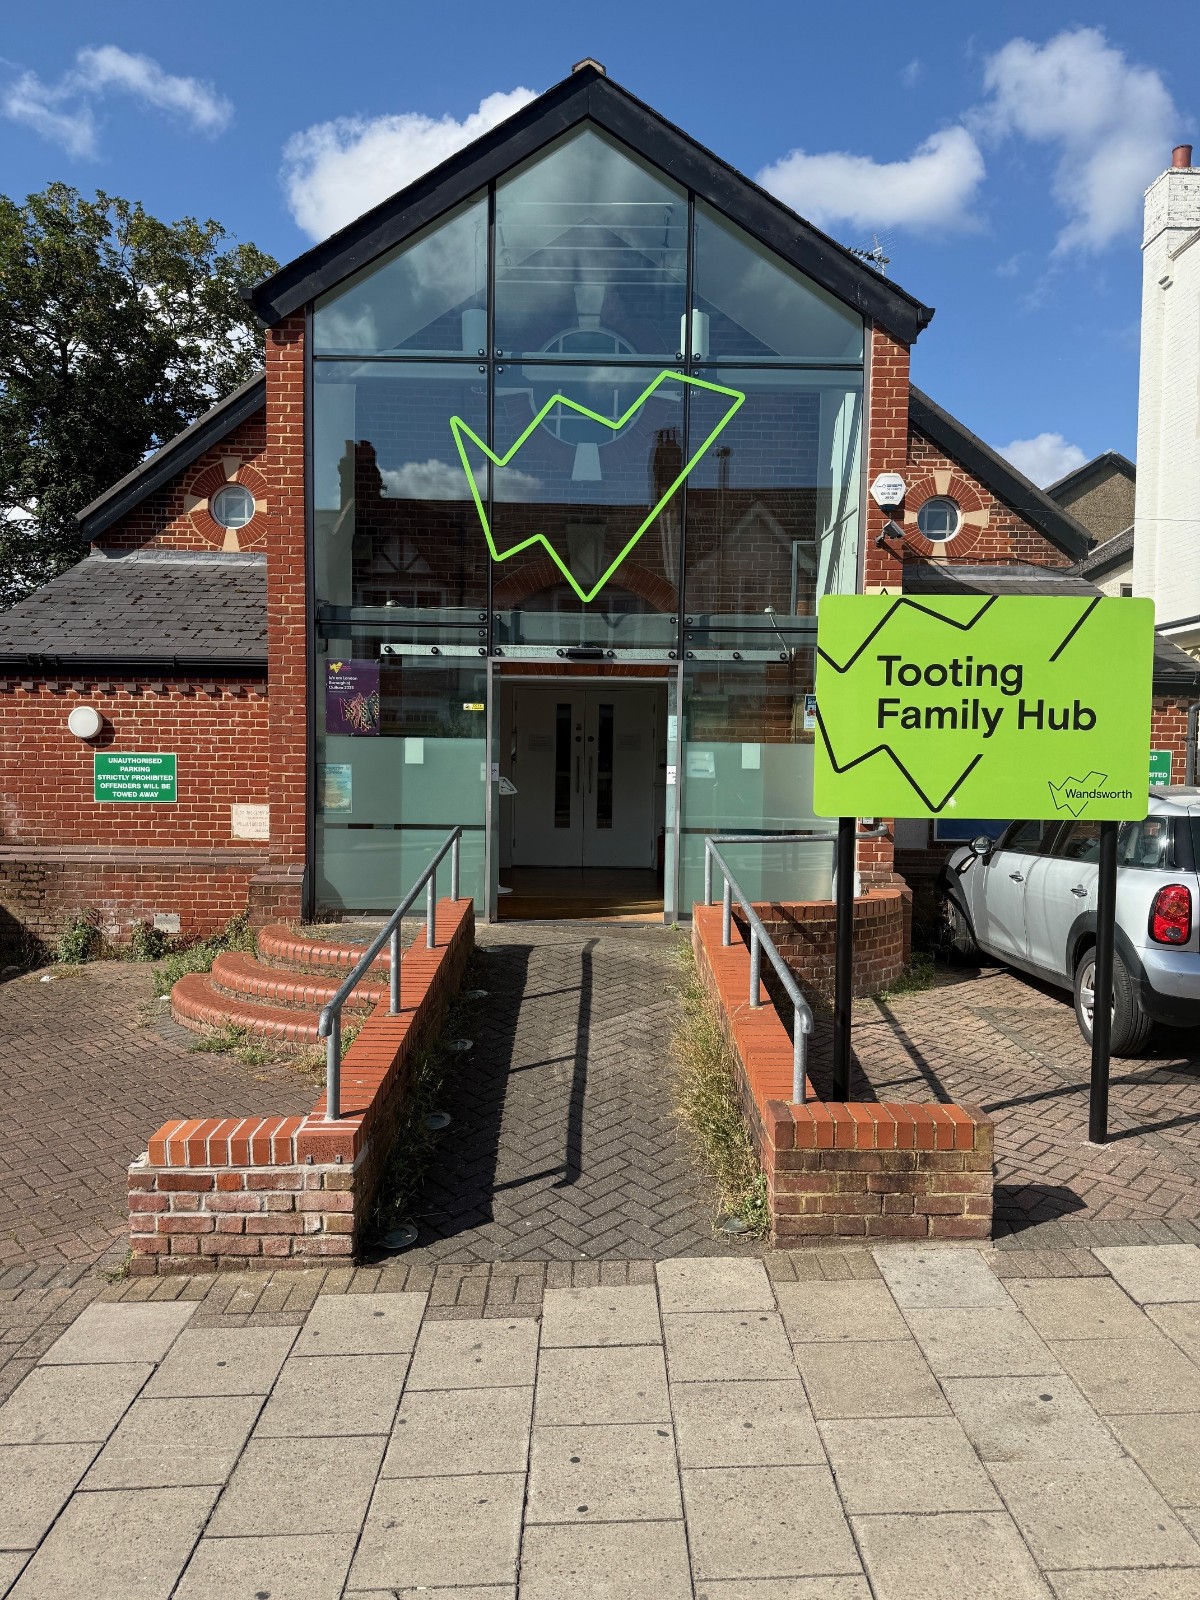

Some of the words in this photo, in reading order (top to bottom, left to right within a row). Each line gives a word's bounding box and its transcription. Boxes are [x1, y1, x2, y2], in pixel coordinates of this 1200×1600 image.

[876, 655, 1023, 696] Tooting
[877, 698, 1004, 738] Family
[1017, 698, 1097, 731] Hub
[1065, 788, 1133, 799] Wandsworth
